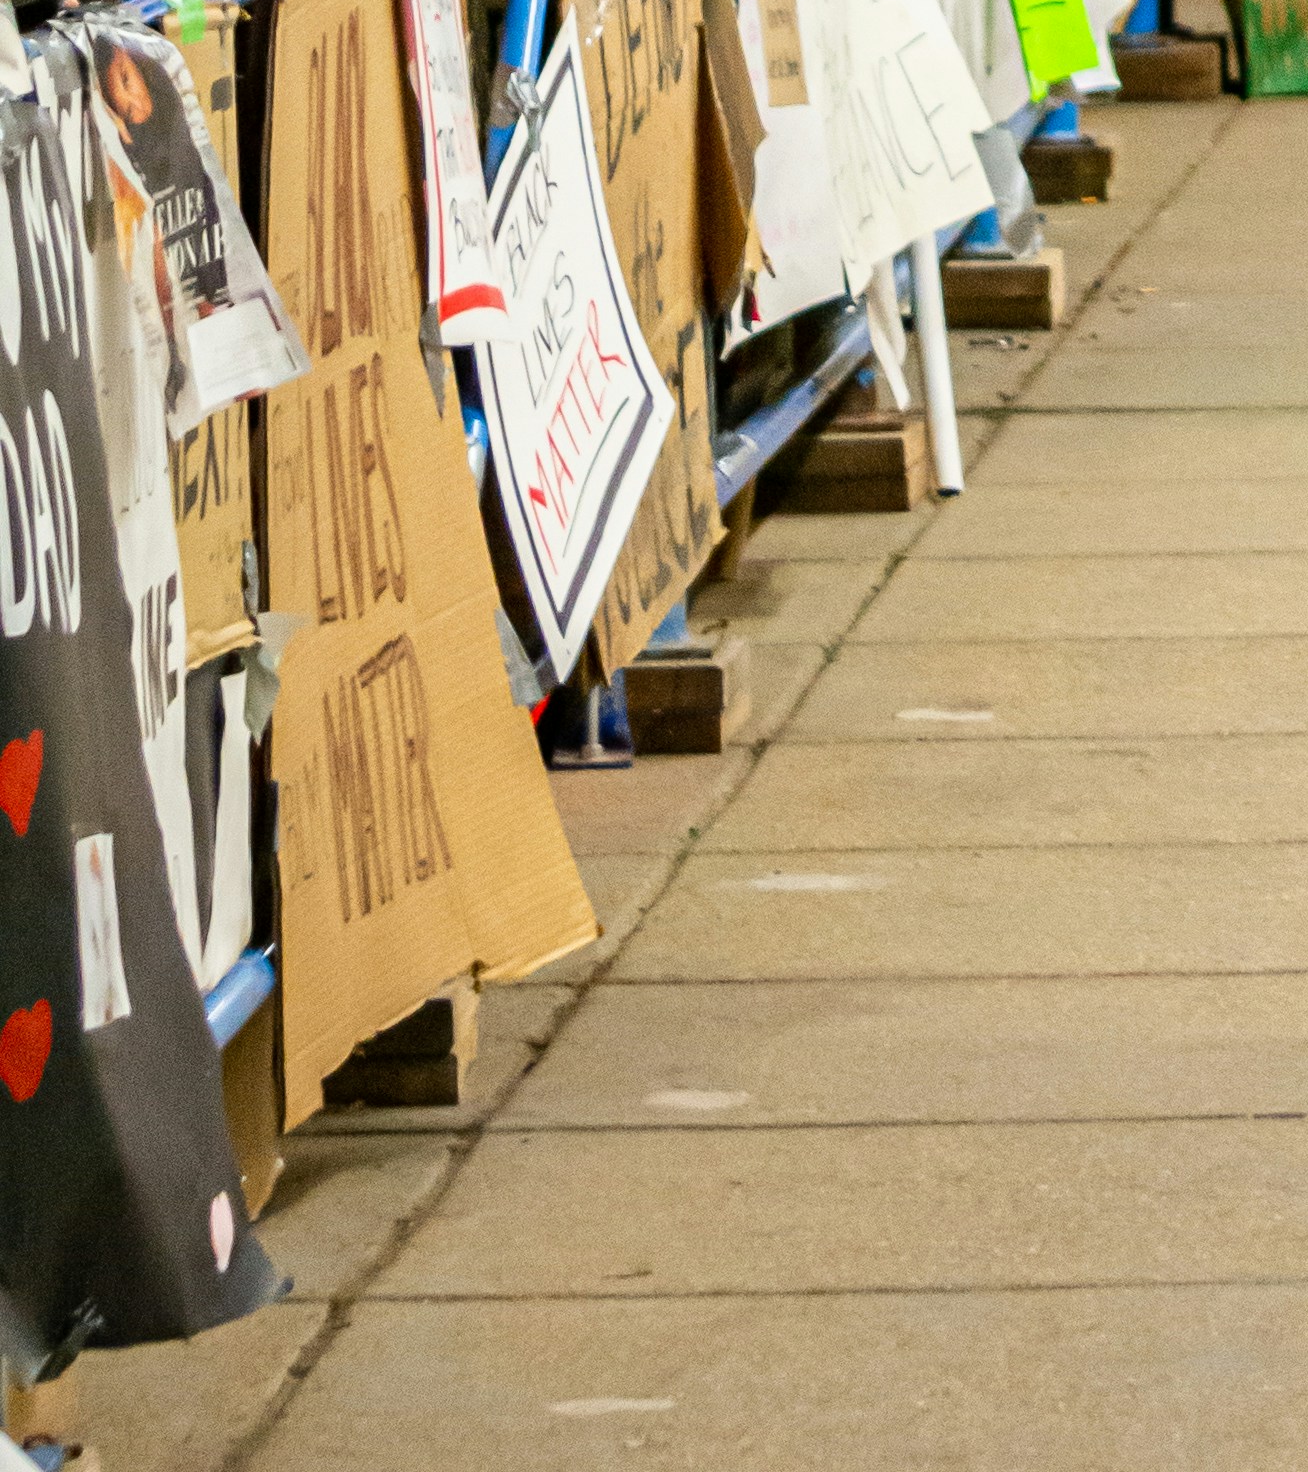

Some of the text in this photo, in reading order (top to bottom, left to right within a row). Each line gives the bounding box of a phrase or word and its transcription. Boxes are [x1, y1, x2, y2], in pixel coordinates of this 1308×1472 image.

[20, 134, 80, 360] MY
[504, 155, 560, 297] BLACK
[519, 250, 576, 409] LIVES
[0, 388, 82, 638] DAD
[305, 350, 407, 624] LIVES
[528, 297, 628, 576] MATTER
